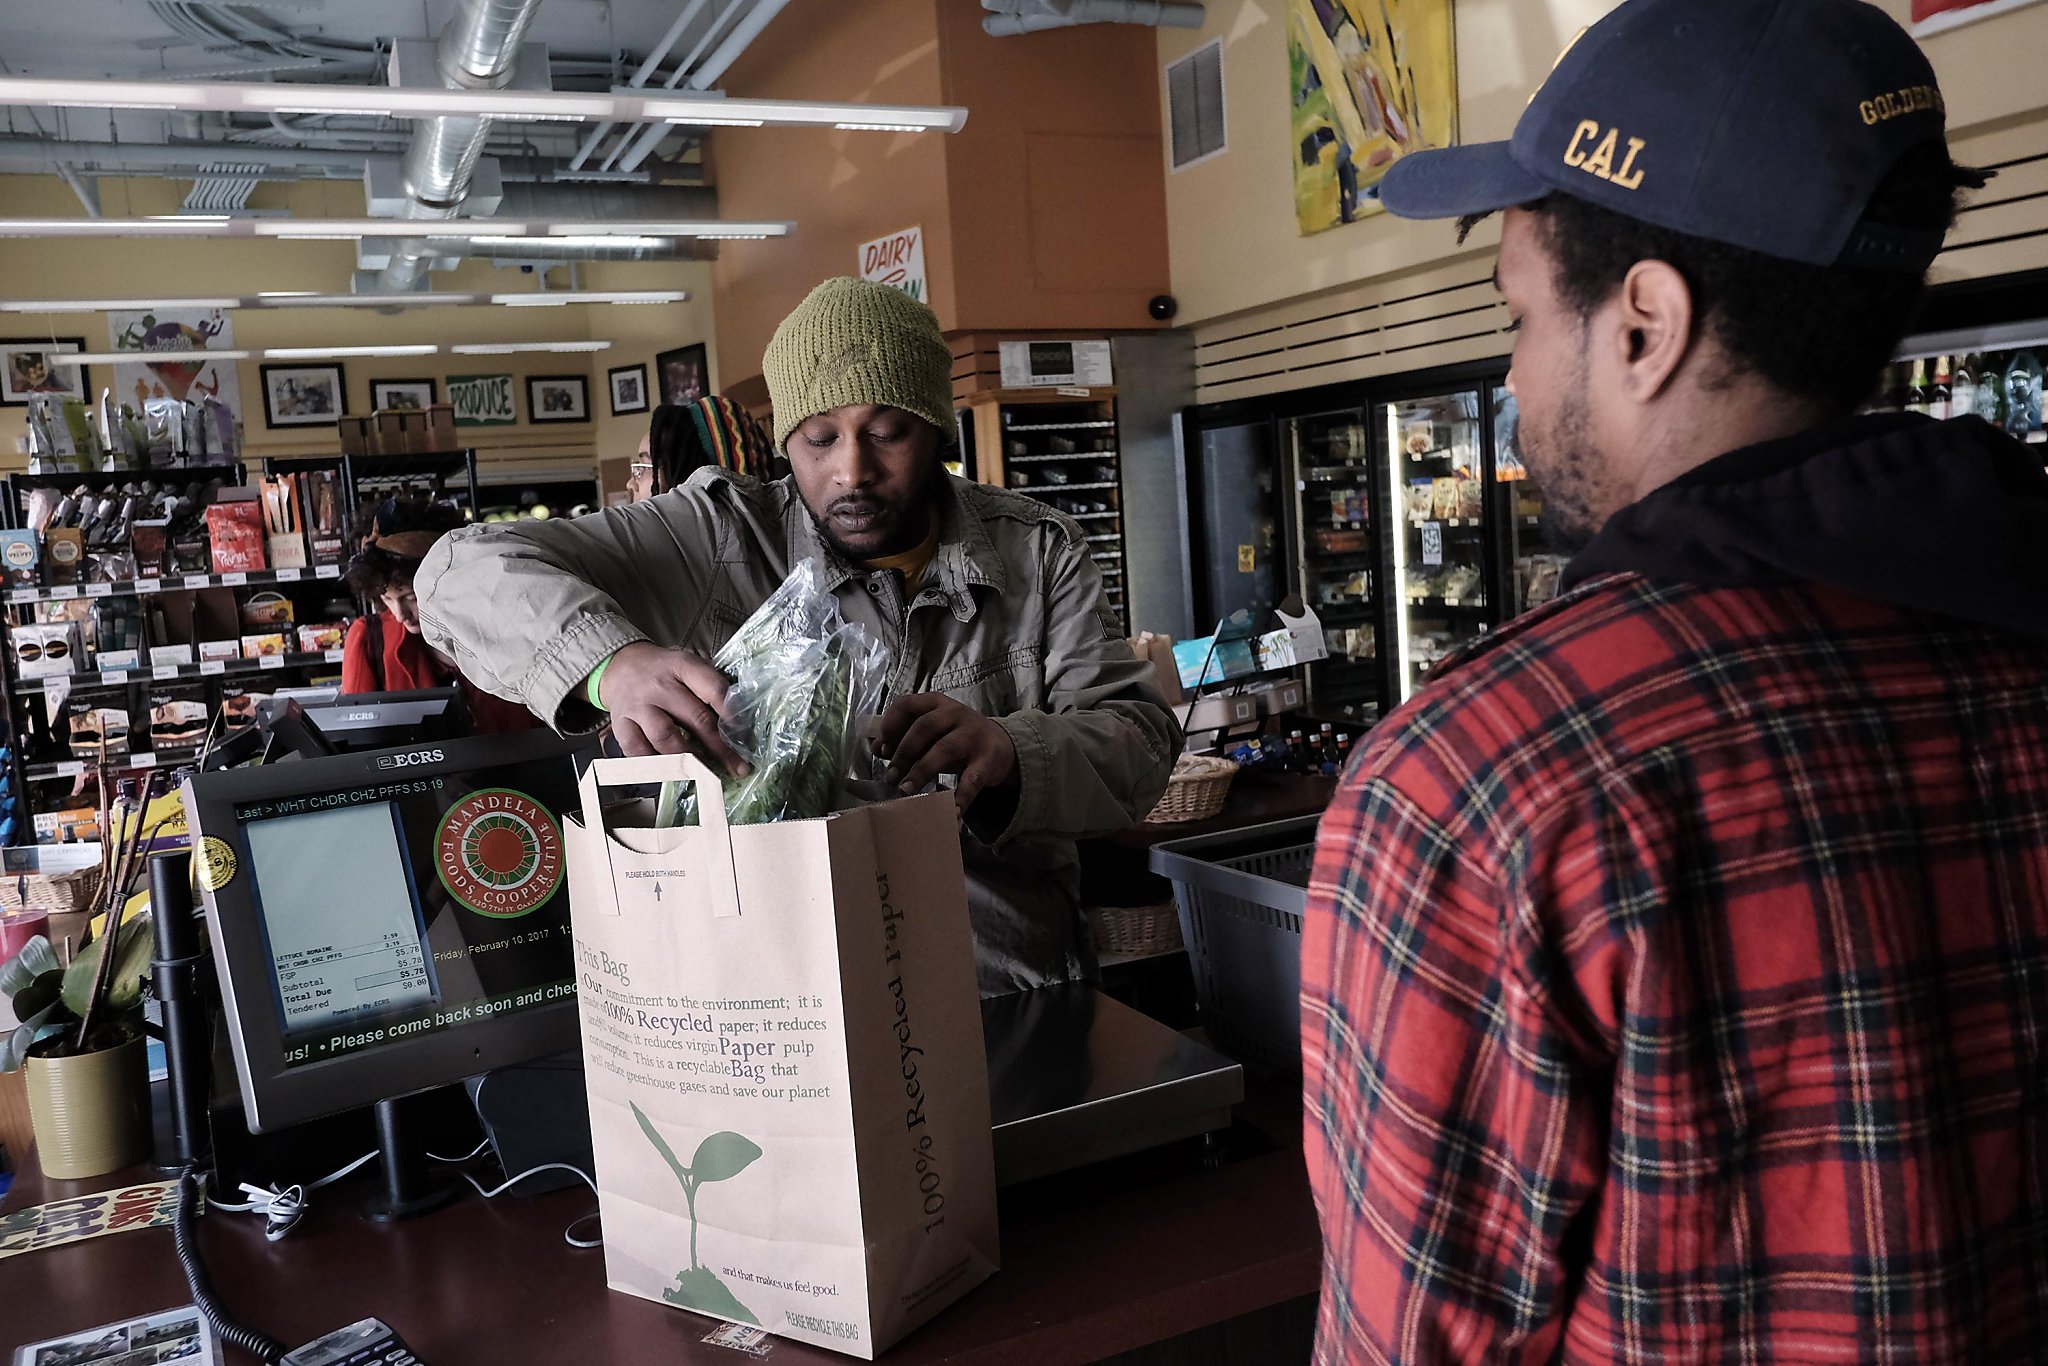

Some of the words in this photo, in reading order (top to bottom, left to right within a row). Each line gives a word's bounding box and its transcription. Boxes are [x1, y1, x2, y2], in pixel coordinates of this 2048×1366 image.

[1563, 119, 1646, 190] CAL
[865, 234, 917, 275] DAIRY
[450, 378, 512, 415] PRODUCE
[8, 551, 32, 559] VELVET
[349, 712, 374, 721] ECRS
[393, 749, 445, 768] ECRS
[236, 807, 262, 820] Last
[276, 800, 306, 814] WHT
[310, 793, 348, 808] CHDR
[350, 789, 376, 802] CHZ
[379, 784, 411, 798] PFFS
[413, 778, 444, 793] $3.19
[446, 796, 538, 834] MANDELA
[442, 842, 476, 895] FOODS
[483, 822, 556, 904] COOPERATIVE
[643, 870, 654, 878] HOLD
[488, 904, 504, 912] 7TH
[384, 932, 398, 940] 2.59
[386, 940, 400, 948] 3.19
[468, 938, 510, 956] February
[528, 930, 550, 942] 2017
[276, 950, 303, 962] LETTUCE
[280, 972, 296, 981] FSP
[396, 946, 420, 957] $5.78
[327, 952, 342, 960] PFFS
[576, 939, 600, 970] This
[600, 951, 630, 986] Bag
[282, 978, 324, 992] Subtotal
[398, 957, 422, 968] $5.78
[285, 992, 310, 1004] Total
[316, 988, 332, 997] Due
[400, 968, 424, 978] $5.78
[584, 972, 602, 994] Our
[606, 988, 664, 1006] commitment
[666, 996, 678, 1008] to
[681, 996, 699, 1008] the
[702, 996, 790, 1011] environment;
[798, 995, 808, 1008] it
[812, 996, 823, 1008] is
[288, 1000, 330, 1015] Tendered
[402, 978, 427, 990] $0.00
[332, 1004, 360, 1016] Powered
[363, 1002, 371, 1010] By
[374, 998, 390, 1008] ECRS
[286, 1044, 310, 1062] us!
[330, 1029, 384, 1052] Please
[388, 1019, 431, 1038] come
[436, 1006, 472, 1026] back
[476, 1000, 512, 1016] soon
[516, 989, 543, 1008] and
[604, 1000, 634, 1025] 100%
[636, 1010, 714, 1036] Recycled
[720, 1021, 759, 1036] paper;
[763, 1019, 773, 1032] it
[778, 1017, 827, 1031] reduces
[634, 1032, 642, 1044] it
[644, 1036, 683, 1050] reduces
[686, 1039, 718, 1055] virgin
[718, 1037, 776, 1062] Paper
[784, 1040, 814, 1058] pulp
[888, 975, 926, 1132] Recycled
[604, 1059, 625, 1078] reduce
[626, 1071, 676, 1090] greenhouse
[680, 1081, 708, 1094] gases
[710, 1084, 730, 1095] and
[733, 1086, 758, 1098] save
[762, 1088, 784, 1098] our
[789, 1085, 830, 1102] planet
[632, 1052, 654, 1067] This
[656, 1057, 664, 1069] is
[667, 1062, 674, 1070] a
[676, 1059, 730, 1076] recyclable
[730, 1059, 766, 1084] Bag
[771, 1062, 798, 1076] that
[914, 1134, 945, 1233] 100%
[722, 1267, 736, 1278] and
[738, 1269, 754, 1282] that
[756, 1275, 782, 1288] makes
[784, 1282, 793, 1290] us
[795, 1280, 810, 1292] feel
[812, 1285, 840, 1298] good.
[786, 1310, 806, 1329] PLEASE
[806, 1316, 830, 1334] RECYCLE
[830, 1320, 846, 1338] THIS
[846, 1323, 858, 1340] BAG
